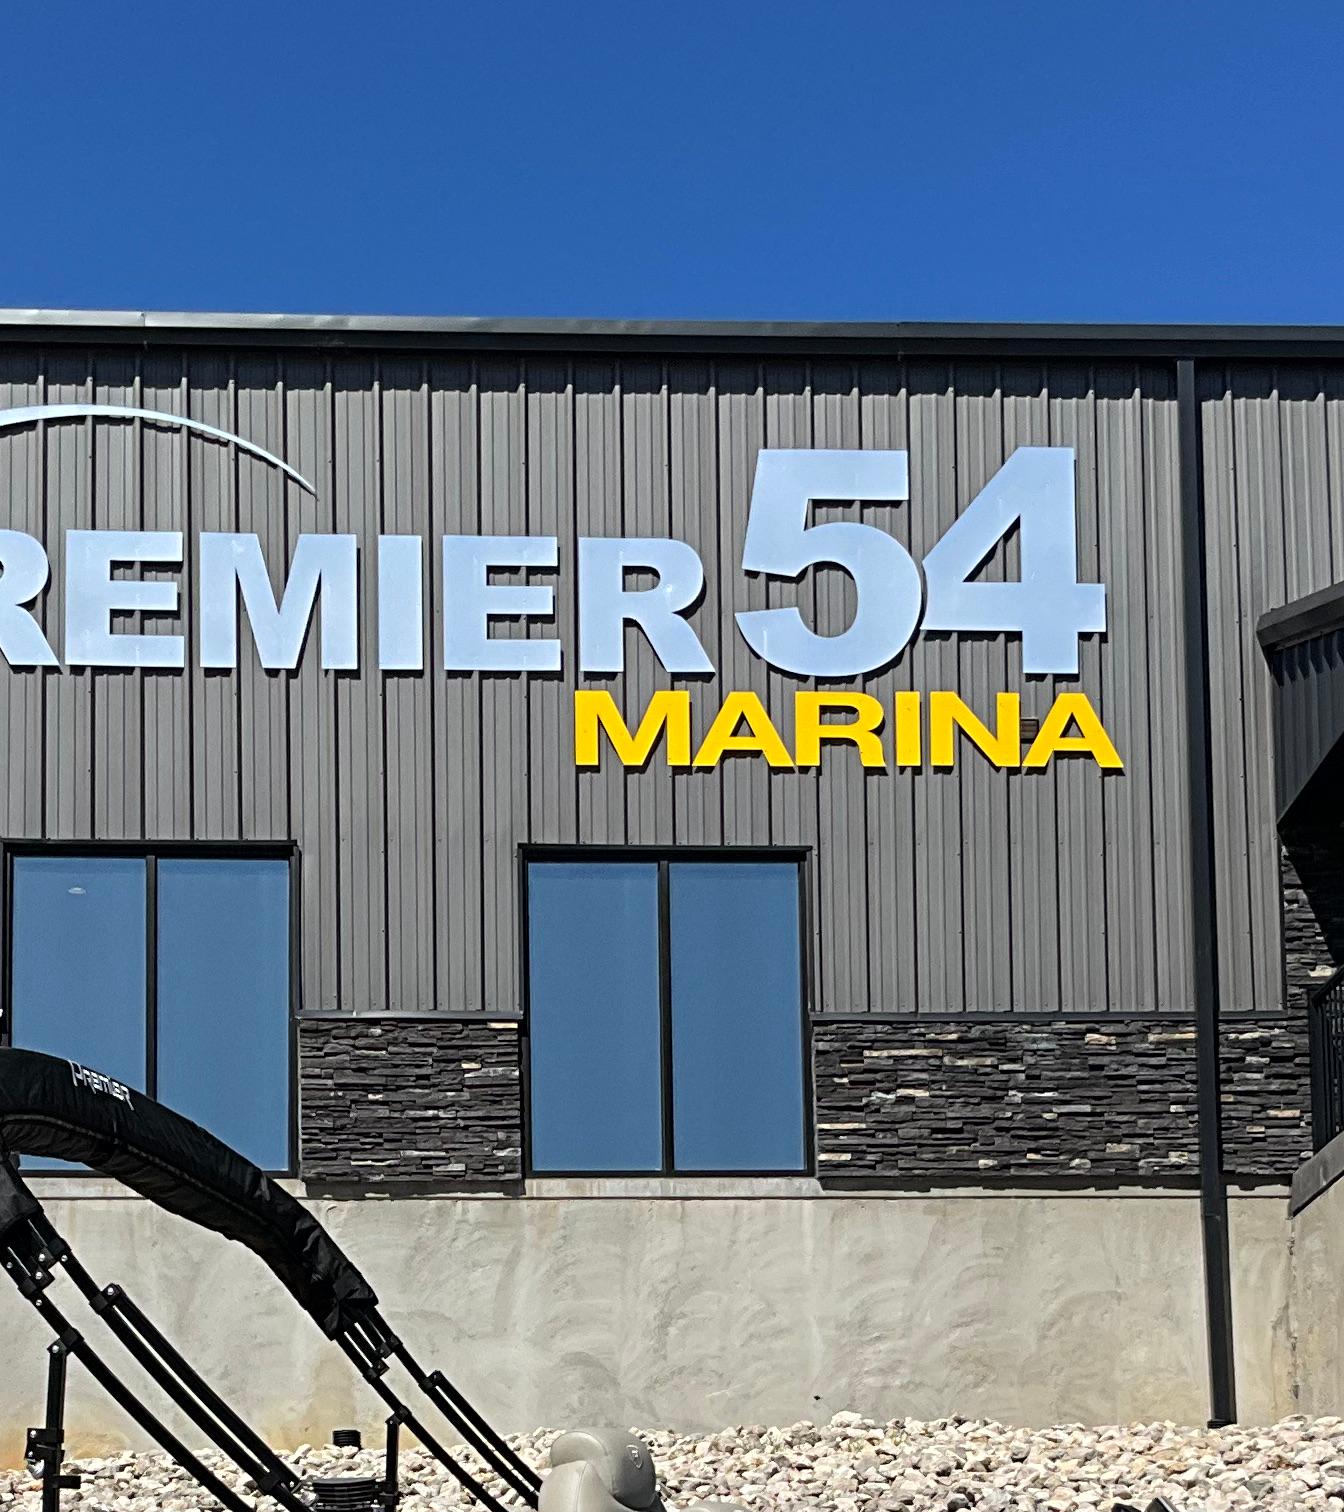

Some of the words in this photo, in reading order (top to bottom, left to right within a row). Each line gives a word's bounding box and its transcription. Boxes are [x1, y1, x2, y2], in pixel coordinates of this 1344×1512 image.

[735, 446, 1106, 678] 54
[574, 690, 1124, 769] MARINA
[67, 1060, 135, 1111] PREMIER
